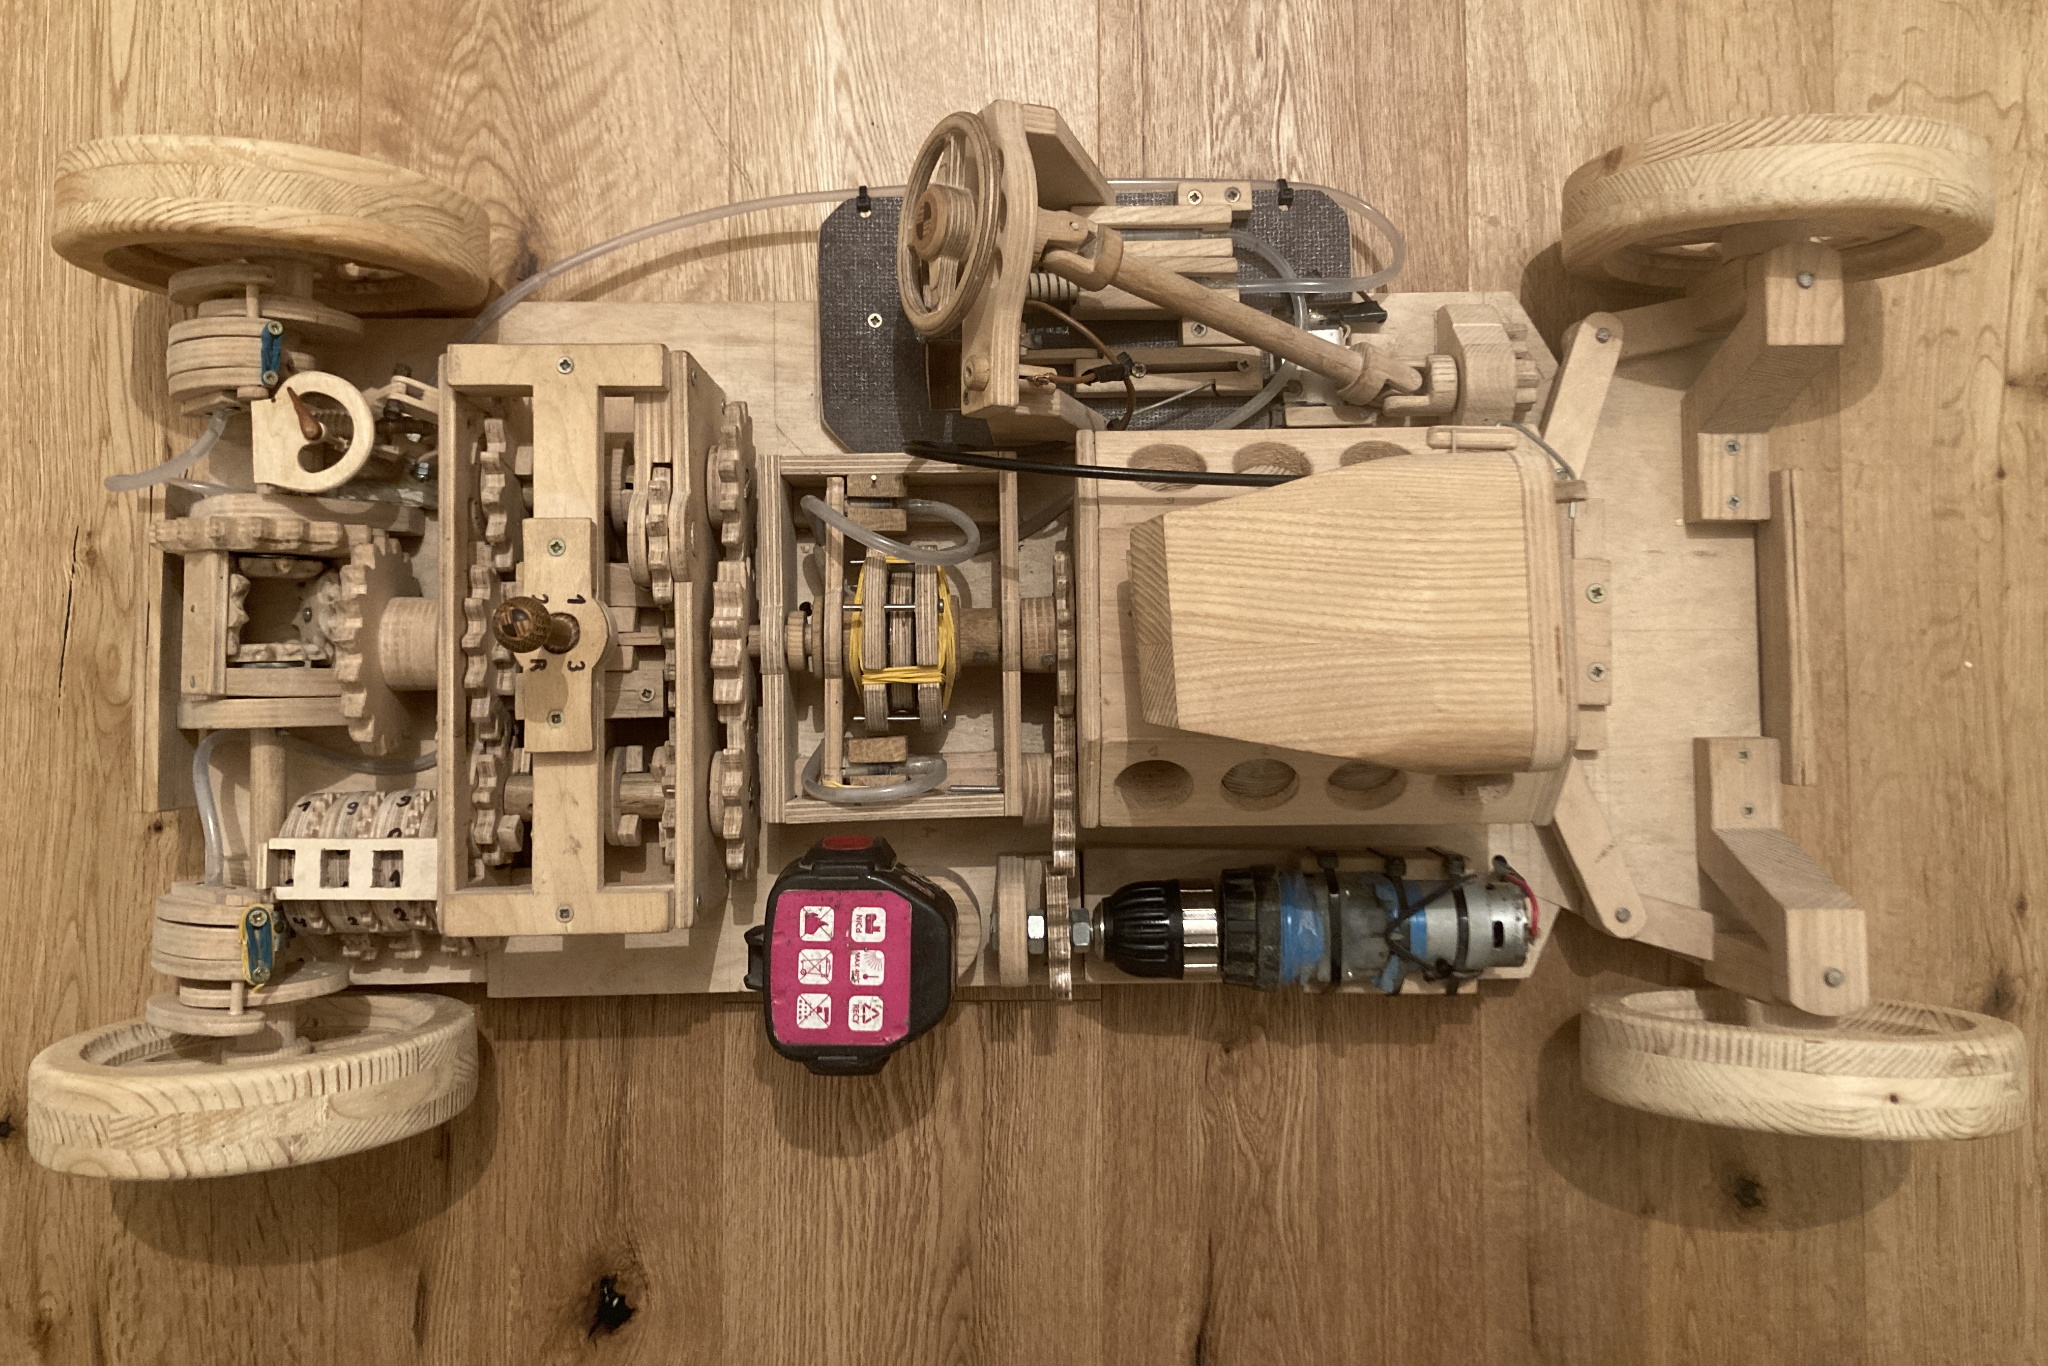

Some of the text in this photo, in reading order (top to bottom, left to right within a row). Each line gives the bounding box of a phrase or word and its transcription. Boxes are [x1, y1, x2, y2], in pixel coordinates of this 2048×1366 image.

[567, 594, 586, 605] 1
[530, 659, 548, 672] R
[567, 660, 586, 672] 3
[347, 801, 359, 815] 9
[852, 1003, 860, 1024] RECY
